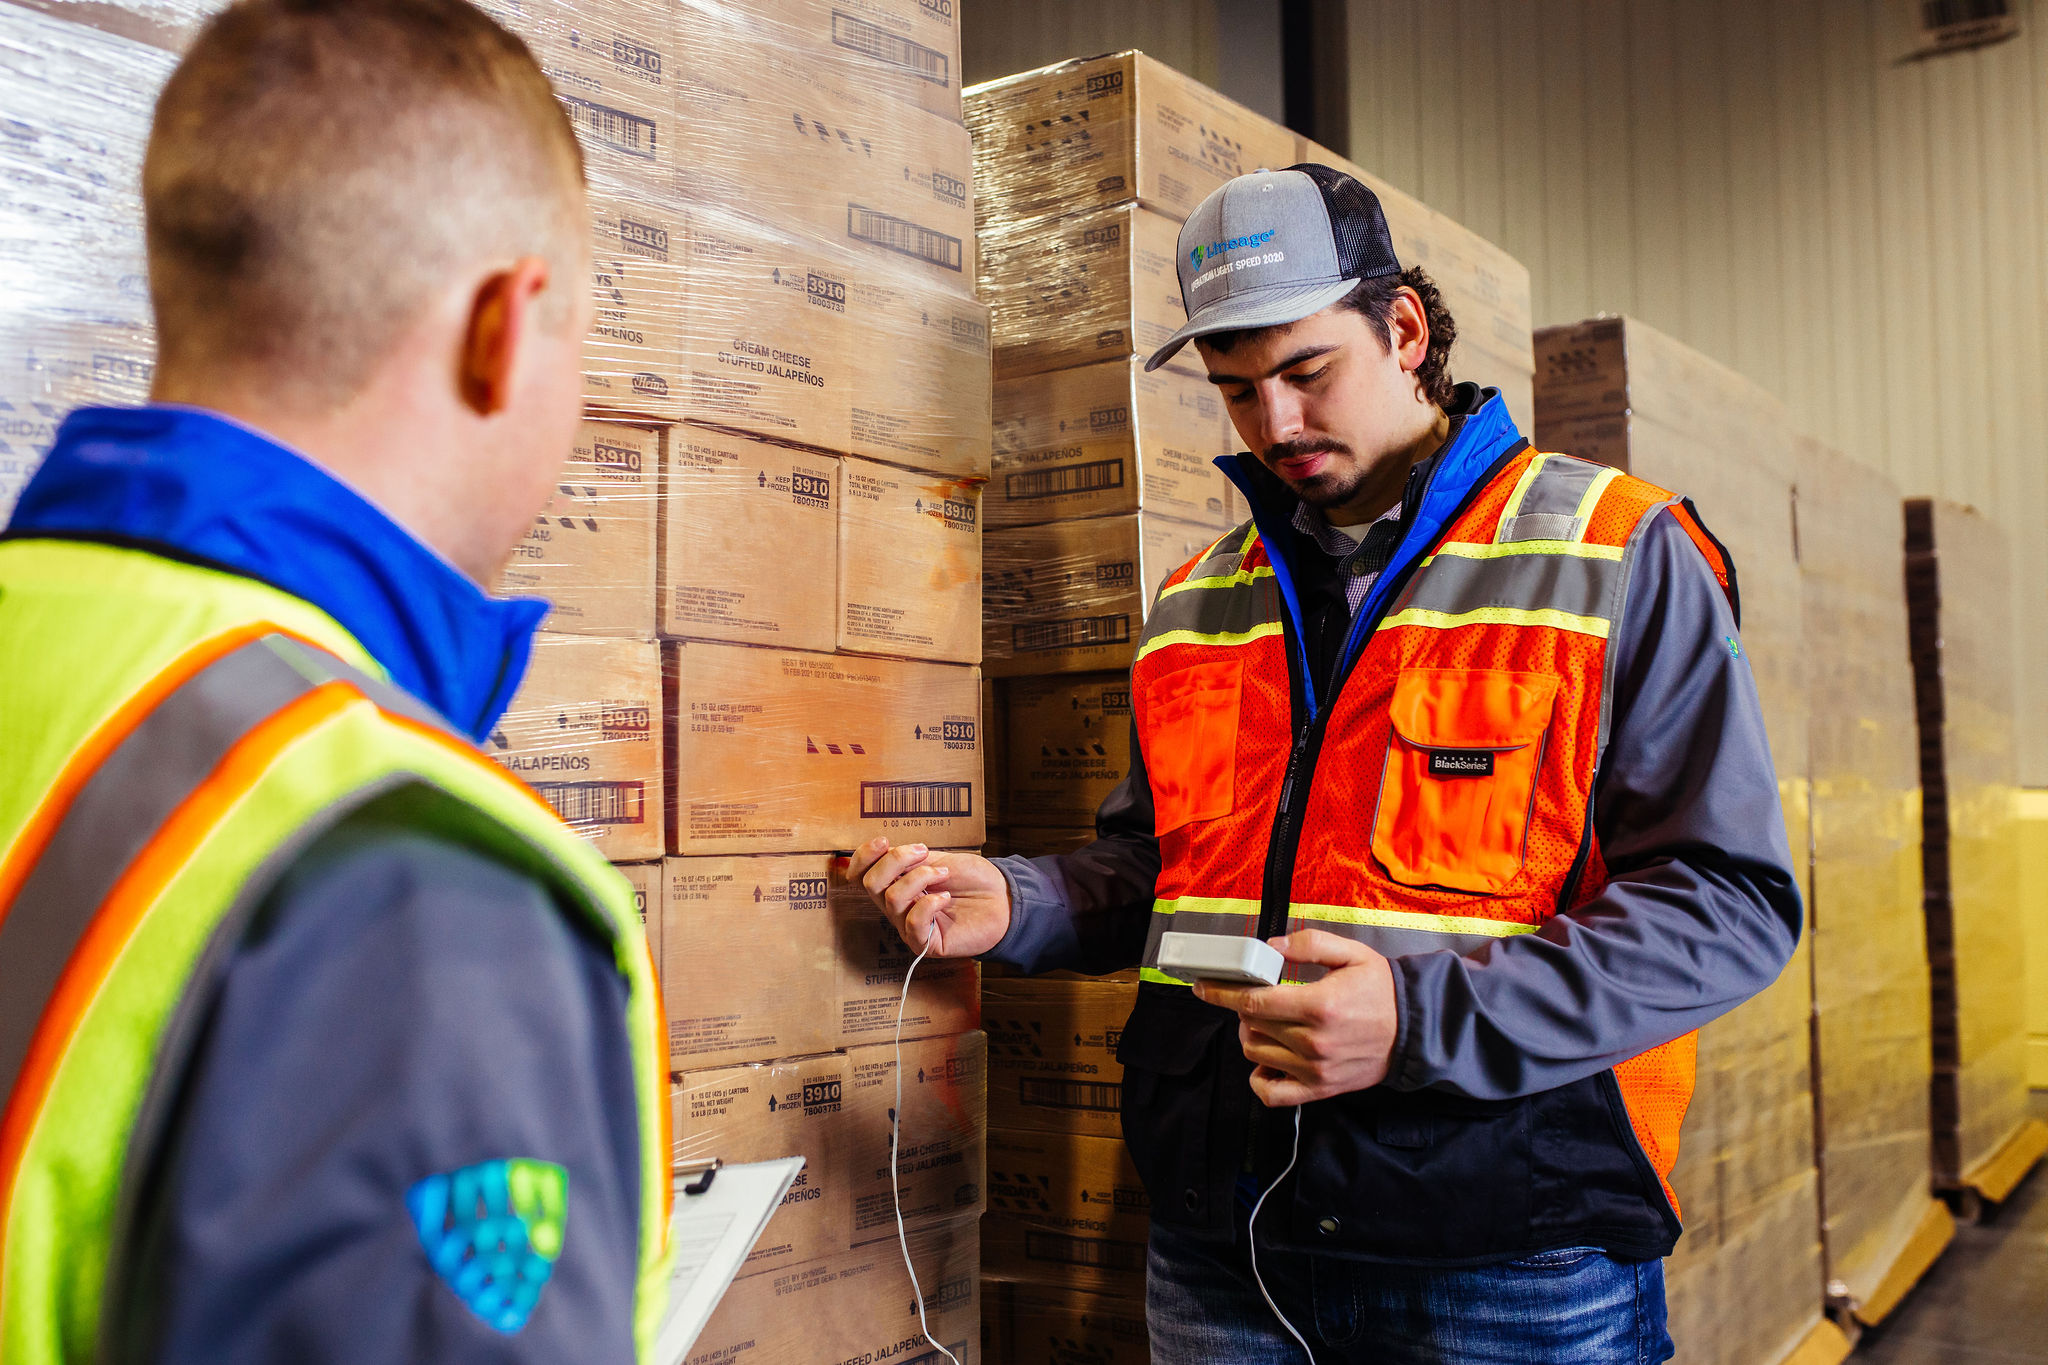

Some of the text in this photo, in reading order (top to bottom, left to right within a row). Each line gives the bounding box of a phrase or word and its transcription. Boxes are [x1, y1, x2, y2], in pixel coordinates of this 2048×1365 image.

[614, 43, 661, 73] 3910
[1089, 73, 1121, 92] 3910
[934, 174, 965, 199] 3910
[622, 221, 667, 248] 3910
[1206, 230, 1272, 259] Lineage
[1235, 256, 1261, 272] SPEED
[1262, 251, 1285, 265] 2020
[808, 276, 845, 301] 3910
[808, 295, 845, 313] 78003733
[596, 326, 644, 345] APEÑOS
[952, 318, 985, 339] 3910
[733, 338, 811, 369] CREAM CHEESE
[718, 351, 825, 388] STUFFED JALAPEÑOS
[1091, 408, 1126, 424] 3910
[596, 447, 640, 470] 3910
[1025, 447, 1083, 463] JALAPEÑOS
[767, 482, 791, 493] FROZEN
[775, 476, 791, 484] KEEP
[793, 475, 829, 497] 3910
[849, 481, 862, 489] TOTAL
[871, 485, 886, 494] WEIGHT
[792, 494, 829, 509] 78003733
[923, 508, 943, 518] FROZEN
[945, 502, 975, 521] 3910
[944, 520, 975, 533] 78003733
[513, 544, 544, 559] FFED
[1099, 564, 1132, 579] 3910
[782, 658, 797, 666] BEST
[790, 668, 813, 677] FEB 2021
[1103, 693, 1131, 706] 391
[717, 704, 730, 712] (425
[737, 704, 763, 713] CARTONS
[603, 710, 648, 728] 3910
[710, 714, 721, 722] NET
[722, 715, 744, 723] WEIGHT
[602, 732, 650, 741] 78003733
[944, 724, 974, 739] 3910
[943, 742, 975, 750] 78003733
[507, 754, 590, 771] JALAPEÑOS
[1073, 759, 1107, 768] CHEESE
[1434, 760, 1488, 770] BlackSeries
[1068, 769, 1119, 780] JALAPEÑOS
[790, 881, 826, 899] 3910
[789, 901, 827, 910] 78003733
[865, 974, 905, 985] STUFFED
[1038, 1060, 1098, 1074] JALAPEÑOS
[728, 1087, 749, 1096] CARTONS
[785, 1093, 801, 1101] KEEP
[805, 1084, 841, 1103] 3910
[692, 1097, 734, 1109] TOTAL NET WEIGHT
[779, 1101, 802, 1110] FROZEN
[804, 1103, 842, 1116] 78003733
[718, 1107, 727, 1115] kg)
[888, 1147, 918, 1162] CEAM
[779, 1187, 821, 1206] APEÑOS
[774, 1276, 790, 1288] BEST
[791, 1273, 799, 1282] BY
[782, 1286, 793, 1294] FEB
[793, 1282, 806, 1292] 2021
[729, 1339, 756, 1353] CARTONS
[700, 1355, 709, 1364] OZ
[709, 1351, 722, 1362] (425
